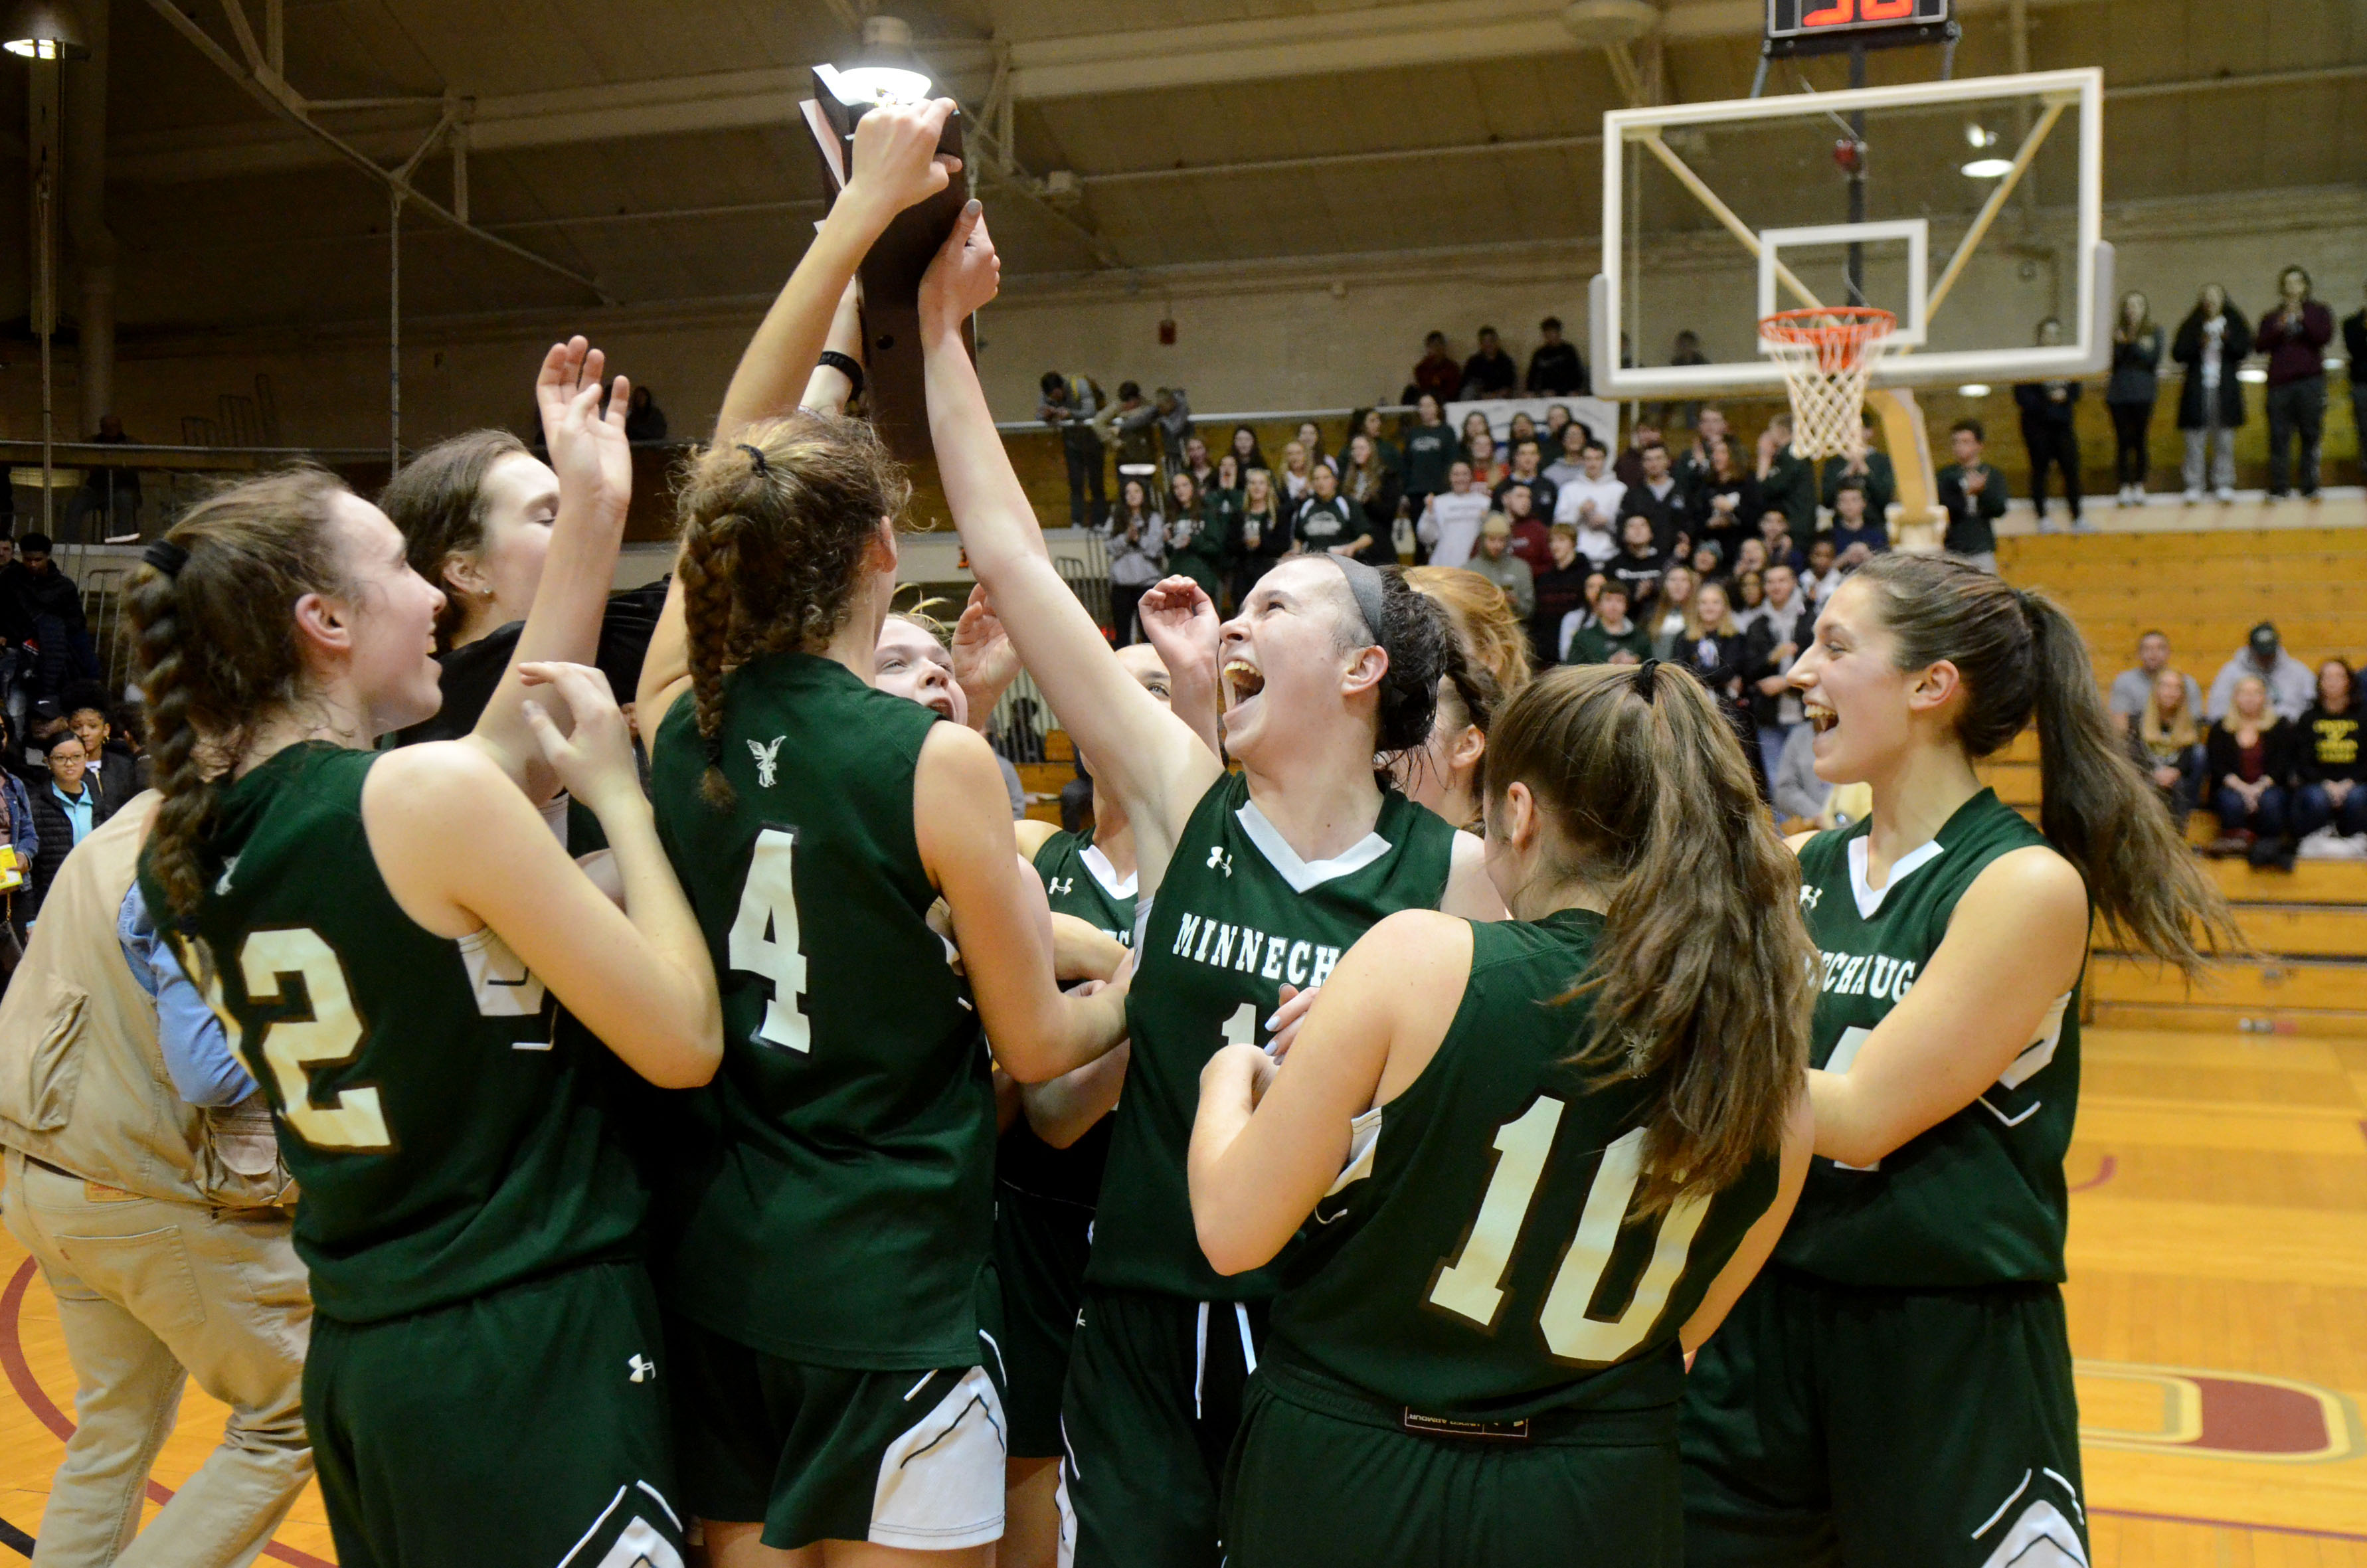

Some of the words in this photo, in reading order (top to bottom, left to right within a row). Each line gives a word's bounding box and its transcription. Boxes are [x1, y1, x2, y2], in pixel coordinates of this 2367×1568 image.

[178, 928, 391, 1147] 2
[729, 829, 811, 1053] 4
[1429, 1094, 1713, 1362] 10
